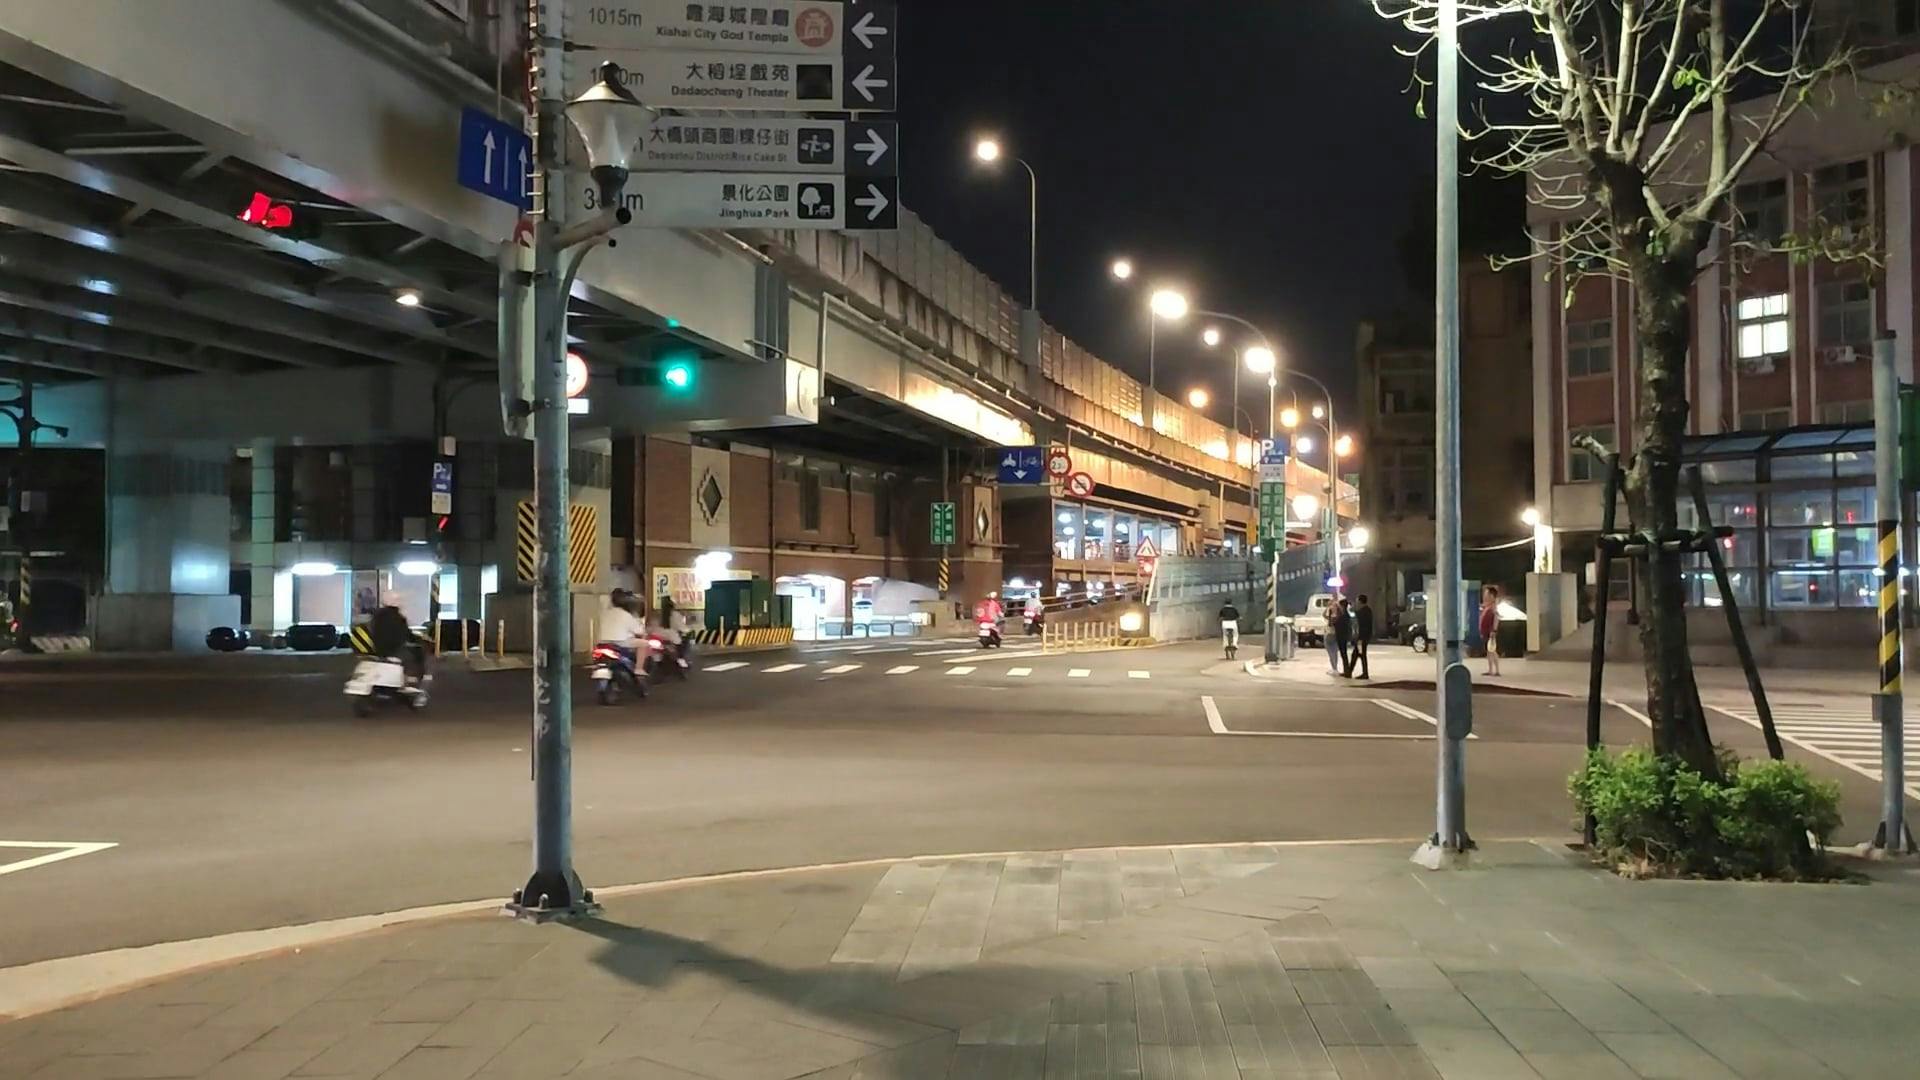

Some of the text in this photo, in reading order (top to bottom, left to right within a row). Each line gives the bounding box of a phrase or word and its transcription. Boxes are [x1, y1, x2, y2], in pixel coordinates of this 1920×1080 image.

[588, 7, 642, 28] 1015m
[656, 26, 789, 44] Xiahai City God Temple
[590, 68, 644, 86] 10m
[686, 63, 789, 81] 大稻埕戲苑
[671, 85, 789, 99] Dadaocheng Theater
[754, 152, 775, 162] Cake
[722, 184, 789, 202] 景化公園
[719, 208, 790, 220] Jinghua Park
